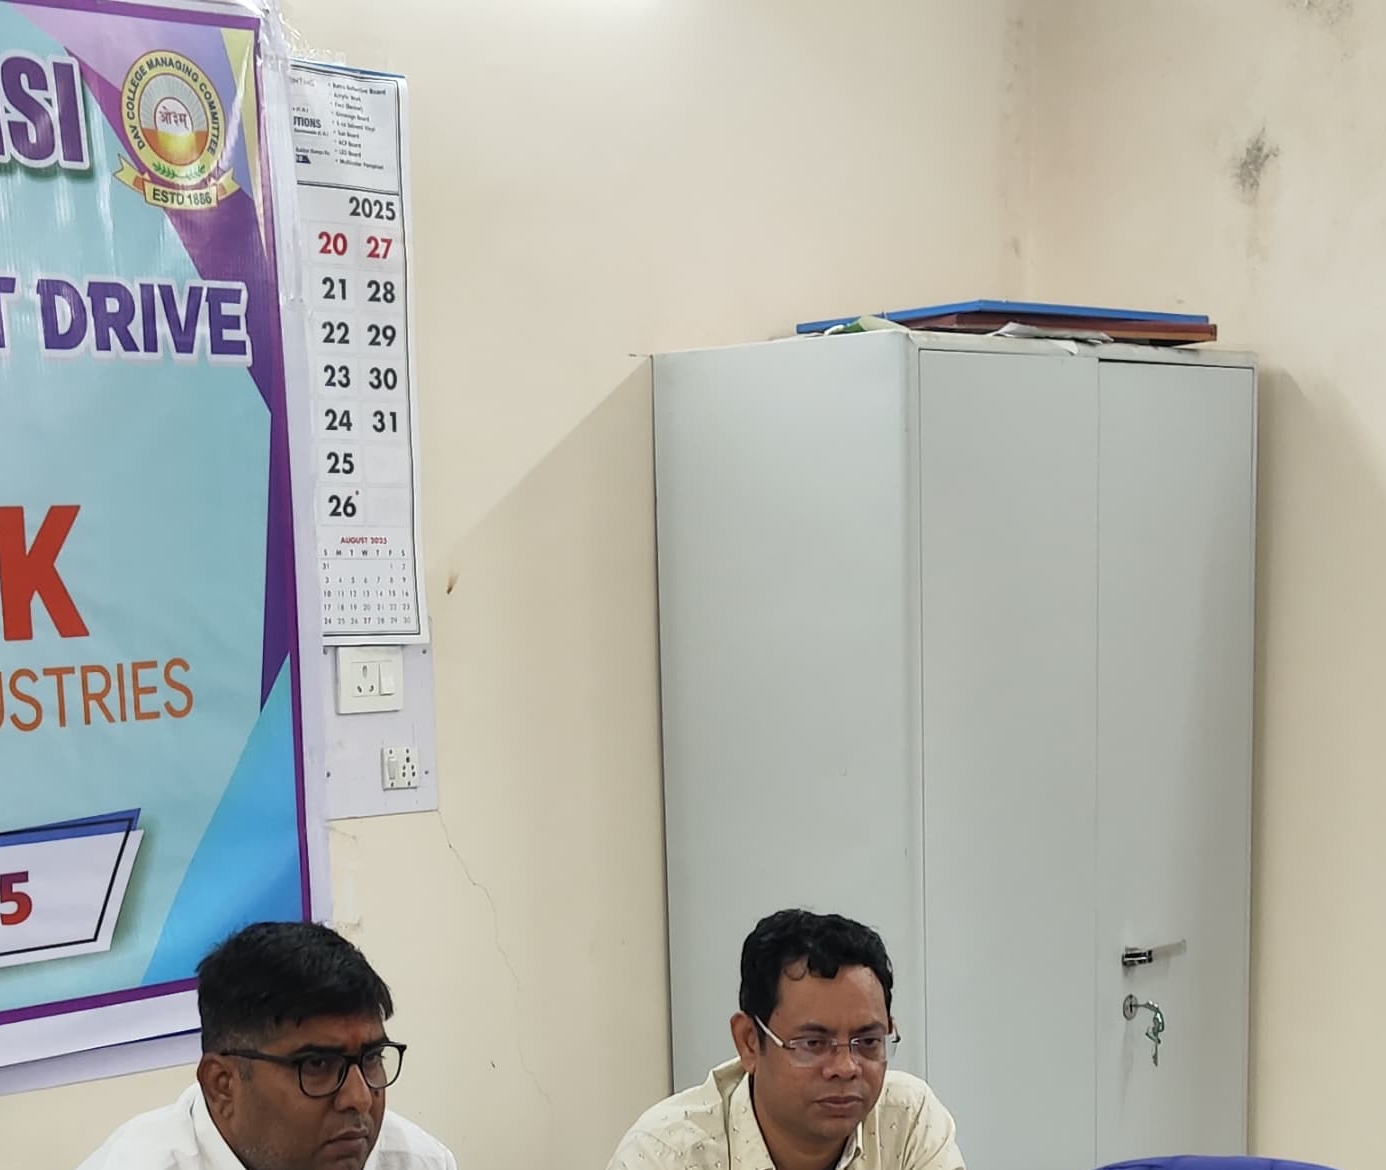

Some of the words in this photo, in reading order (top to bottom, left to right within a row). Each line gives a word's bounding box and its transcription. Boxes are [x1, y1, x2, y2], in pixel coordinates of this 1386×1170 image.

[145, 56, 200, 83] MANAGING
[126, 65, 148, 120] COLLEGE
[199, 83, 220, 154] COMMITTEE
[130, 124, 146, 150] DAV
[152, 187, 185, 206] ESTD
[349, 196, 396, 221] 2025
[318, 231, 348, 256] 20
[366, 235, 393, 260] 27
[321, 276, 347, 301] 21
[367, 280, 396, 304] 28
[36, 278, 248, 358] DRIVE
[321, 321, 350, 345] 22
[367, 324, 397, 347] 29
[323, 364, 351, 388] 23
[369, 367, 398, 390] 30
[324, 408, 353, 431] 24
[372, 410, 398, 433] 31
[326, 451, 355, 475] 25
[328, 494, 357, 518] 26
